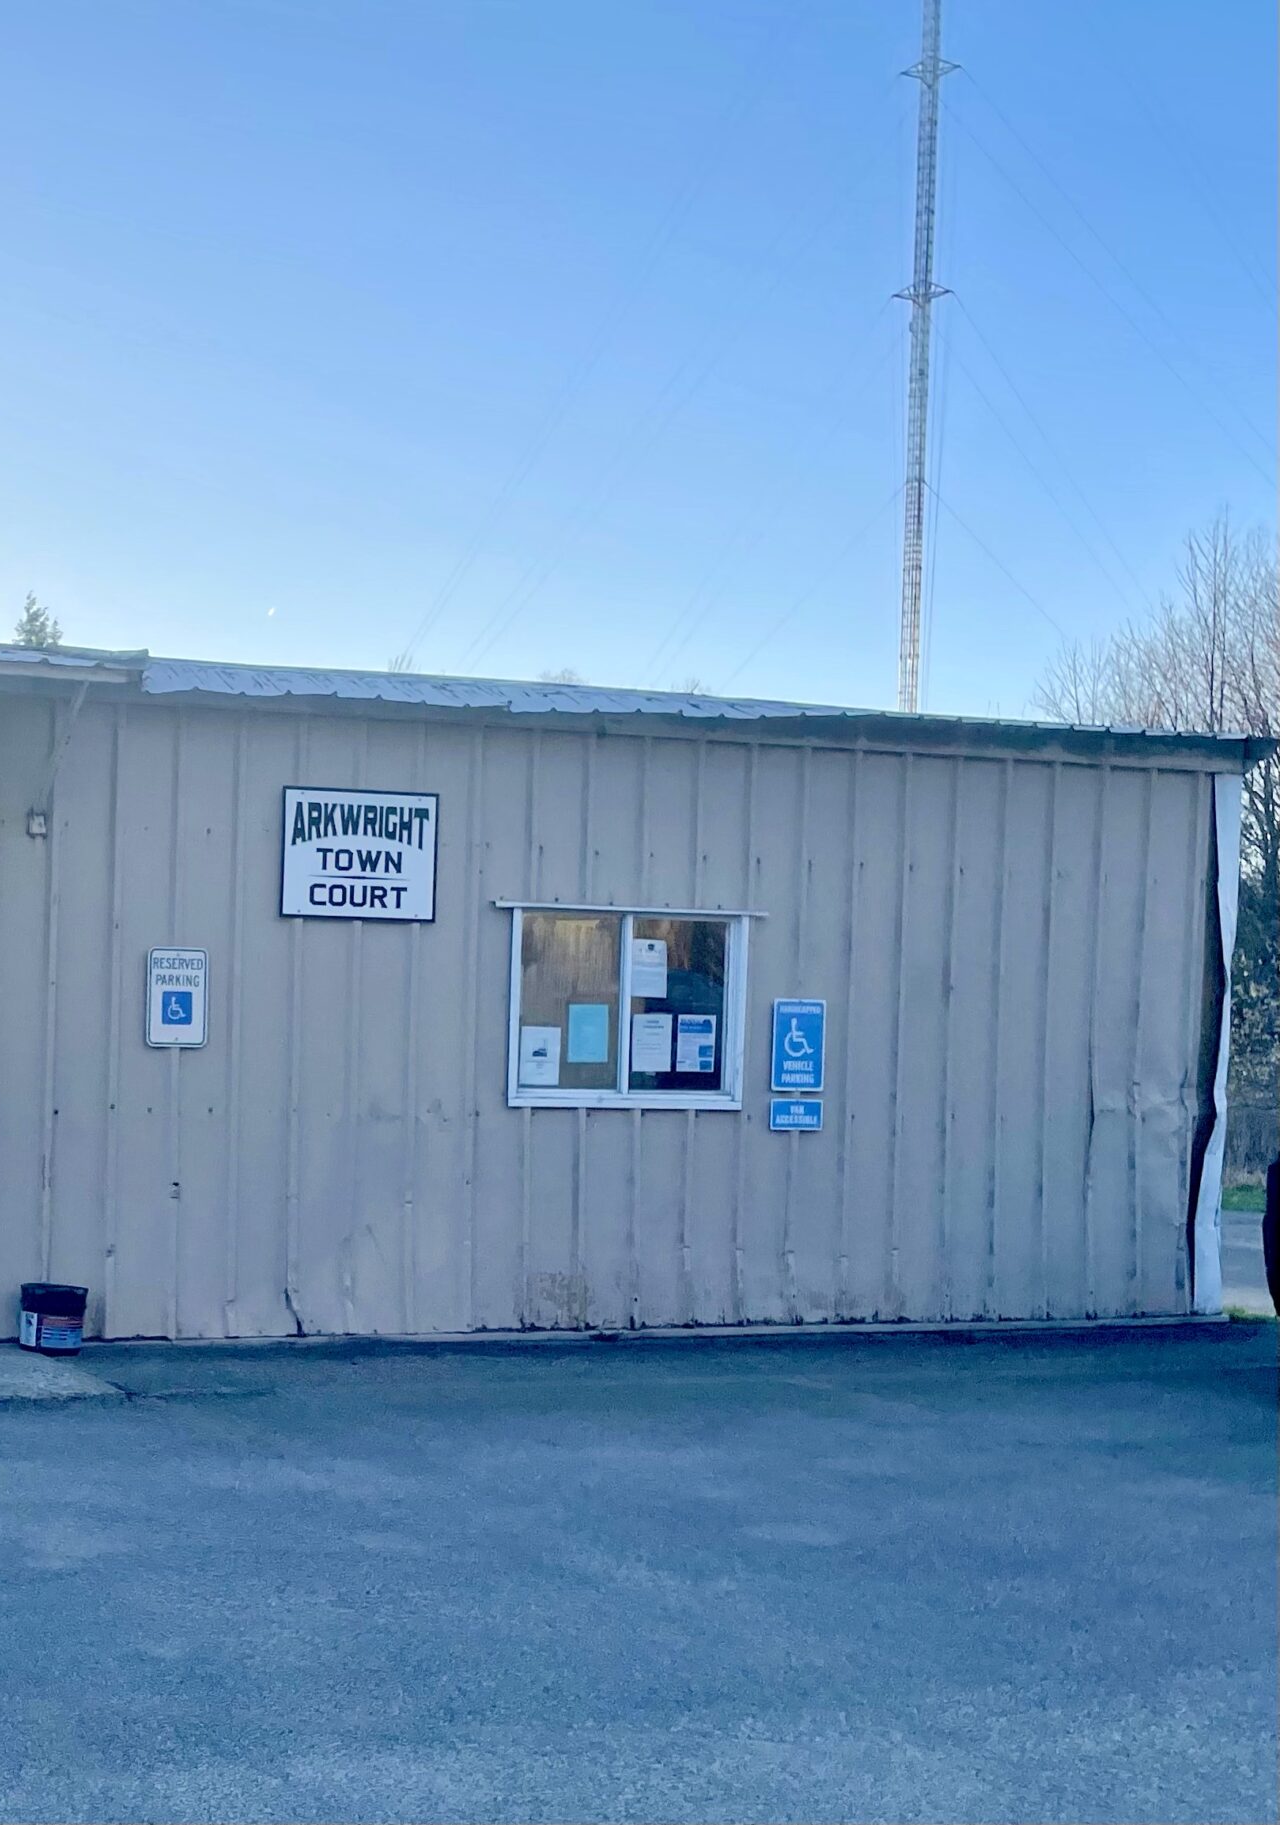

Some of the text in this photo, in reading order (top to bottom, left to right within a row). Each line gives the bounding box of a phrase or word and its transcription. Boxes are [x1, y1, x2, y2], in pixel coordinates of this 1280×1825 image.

[291, 801, 430, 850] ARKWRIGHT
[316, 847, 403, 874] TOWN
[308, 883, 408, 909] COURT
[152, 957, 204, 970] RESERVED
[155, 974, 200, 988] PARKING
[783, 1060, 814, 1072] VEHICLE
[781, 1073, 815, 1084] PARKING
[789, 1104, 805, 1115] VAN
